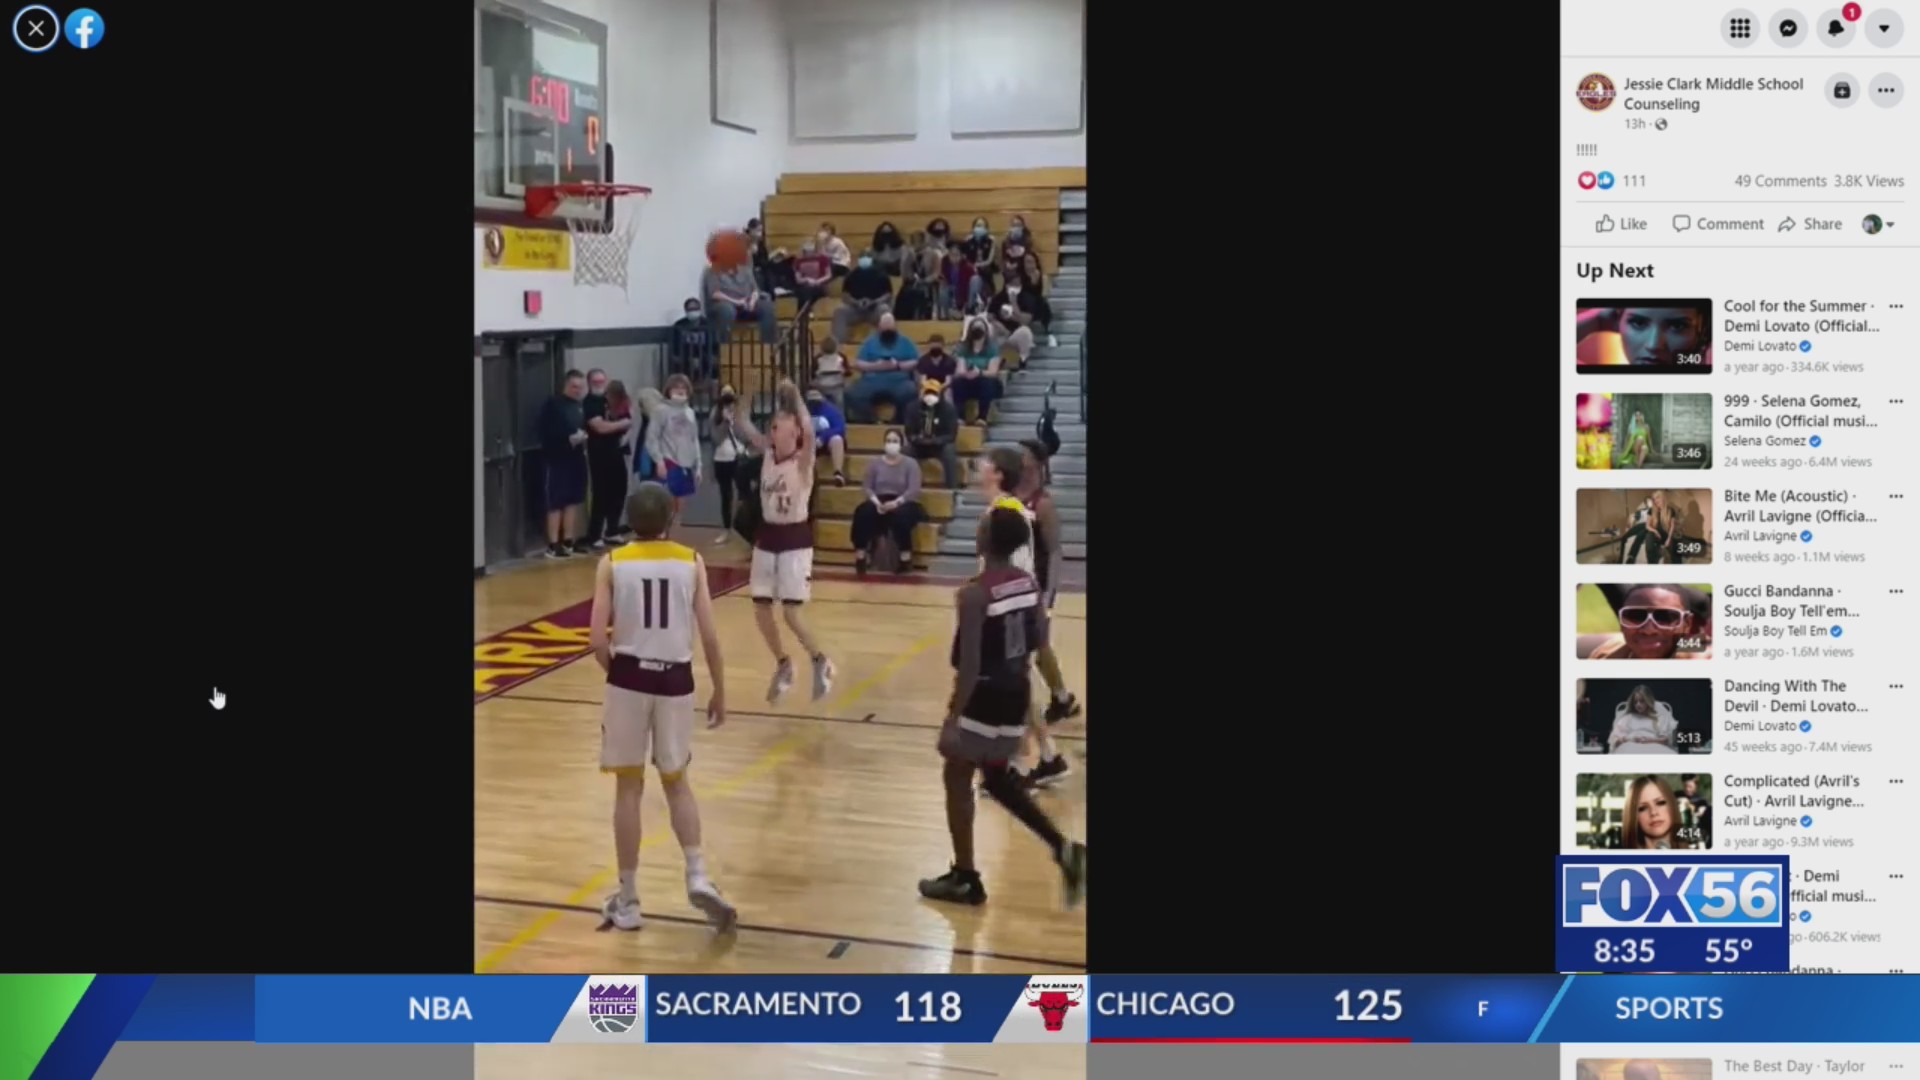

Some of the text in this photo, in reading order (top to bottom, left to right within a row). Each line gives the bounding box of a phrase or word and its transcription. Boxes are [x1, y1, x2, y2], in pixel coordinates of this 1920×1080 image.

[1848, 8, 1855, 19] 1
[1624, 77, 1664, 91] Jessie
[1666, 77, 1702, 91] Clark
[1706, 77, 1754, 91] Middle
[1757, 77, 1804, 91] School
[1623, 96, 1701, 114] Counseling
[1625, 118, 1646, 130] 13h
[1623, 174, 1645, 187] 111
[1735, 174, 1905, 187] 49 Comments 3.8K Views
[1620, 218, 1648, 230] Like
[1697, 217, 1765, 231] Comment
[1804, 217, 1843, 231] Share
[1576, 261, 1655, 284] Up Next
[1723, 299, 1868, 313] Cool for the Summer
[1724, 318, 1880, 334] Demi Lovato (Official...
[1724, 340, 1797, 352] Demi Lovato
[1676, 353, 1702, 364] 3:40
[1723, 361, 1864, 376] a year ago 334.6K views
[1723, 393, 1861, 409] 999 Selena Gomez,
[1723, 414, 1878, 429] Camilo (Official musi...
[1724, 435, 1807, 447] Selena Gomez
[1676, 448, 1702, 459] 3:46
[1724, 454, 1873, 471] 24 weeks ago 6.4M views
[1724, 488, 1849, 504] Bite Me (Acoustic)
[1723, 509, 1877, 526] Avril Lavigne (Officia...
[1724, 530, 1798, 545] Avril Lavigne
[1676, 543, 1702, 554] 3:49
[1723, 550, 1866, 566] 8 weeks ago 1.1M views
[1723, 584, 1834, 598] Gucci Bandanna
[641, 577, 669, 629] 11
[1724, 603, 1860, 621] Soulja Boy Tell'em...
[1724, 624, 1828, 640] Soulja Boy Tell Em
[1676, 638, 1702, 649] 4:44
[1723, 646, 1855, 661] a year ago 1.6M views
[1724, 678, 1847, 696] Dancing With The
[1724, 698, 1869, 713] Devil Demi Lovato...
[1724, 720, 1797, 732] Demi Lovato
[1676, 733, 1702, 744] 5:13
[1723, 740, 1873, 756] 45 weeks ago 7.4M views
[1723, 774, 1861, 790] Complicated (Avril's
[1723, 794, 1864, 811] Cut) Avril Lavigne...
[1724, 815, 1798, 830] Avril Lavigne
[1676, 828, 1702, 839] 4:14
[1723, 836, 1855, 851] a year ago 9.3M views
[1803, 869, 1840, 883] Demi
[1790, 889, 1876, 903] fficial musi...
[1808, 931, 1847, 943] 606.2K
[1724, 1059, 1865, 1075] The Best Day Taylor
